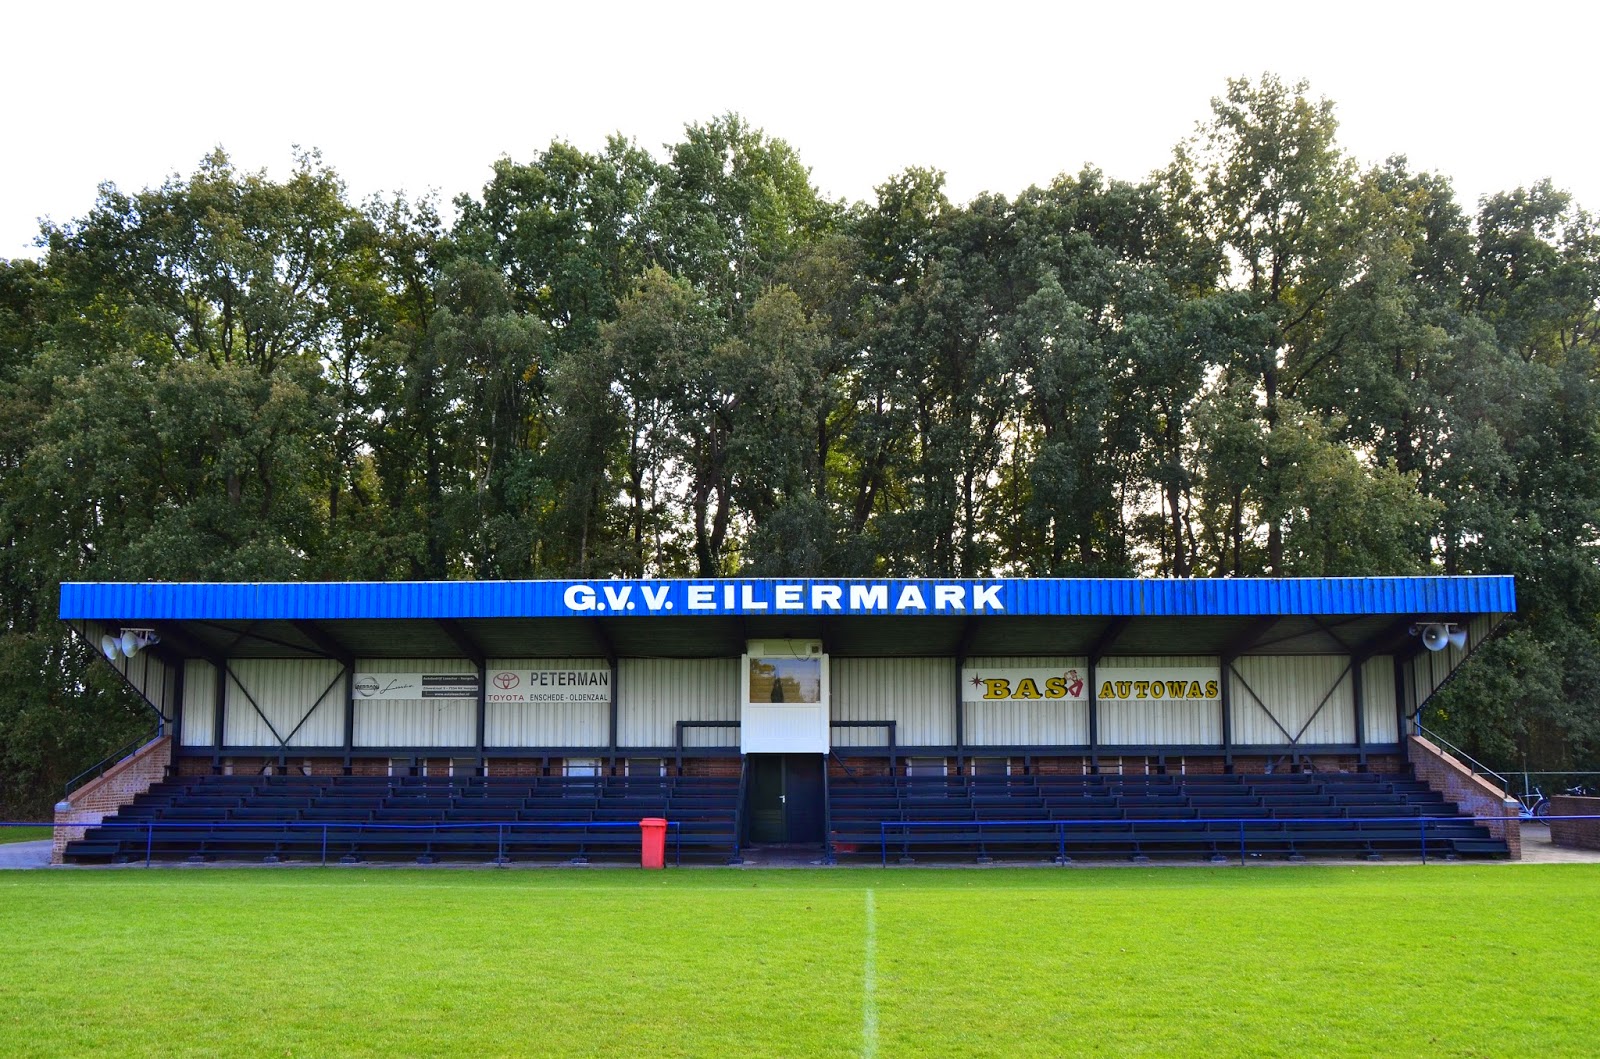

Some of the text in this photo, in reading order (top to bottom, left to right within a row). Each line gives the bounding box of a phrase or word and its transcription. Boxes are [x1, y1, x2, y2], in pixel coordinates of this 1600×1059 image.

[563, 584, 1005, 611] G.V.V. EILERMARK
[530, 672, 608, 686] PETERMAN
[982, 677, 1069, 699] BAS
[530, 693, 564, 701] ENSCHEDE
[569, 693, 608, 701] OLDENZAAL
[1098, 680, 1218, 699] AUTOWAS
